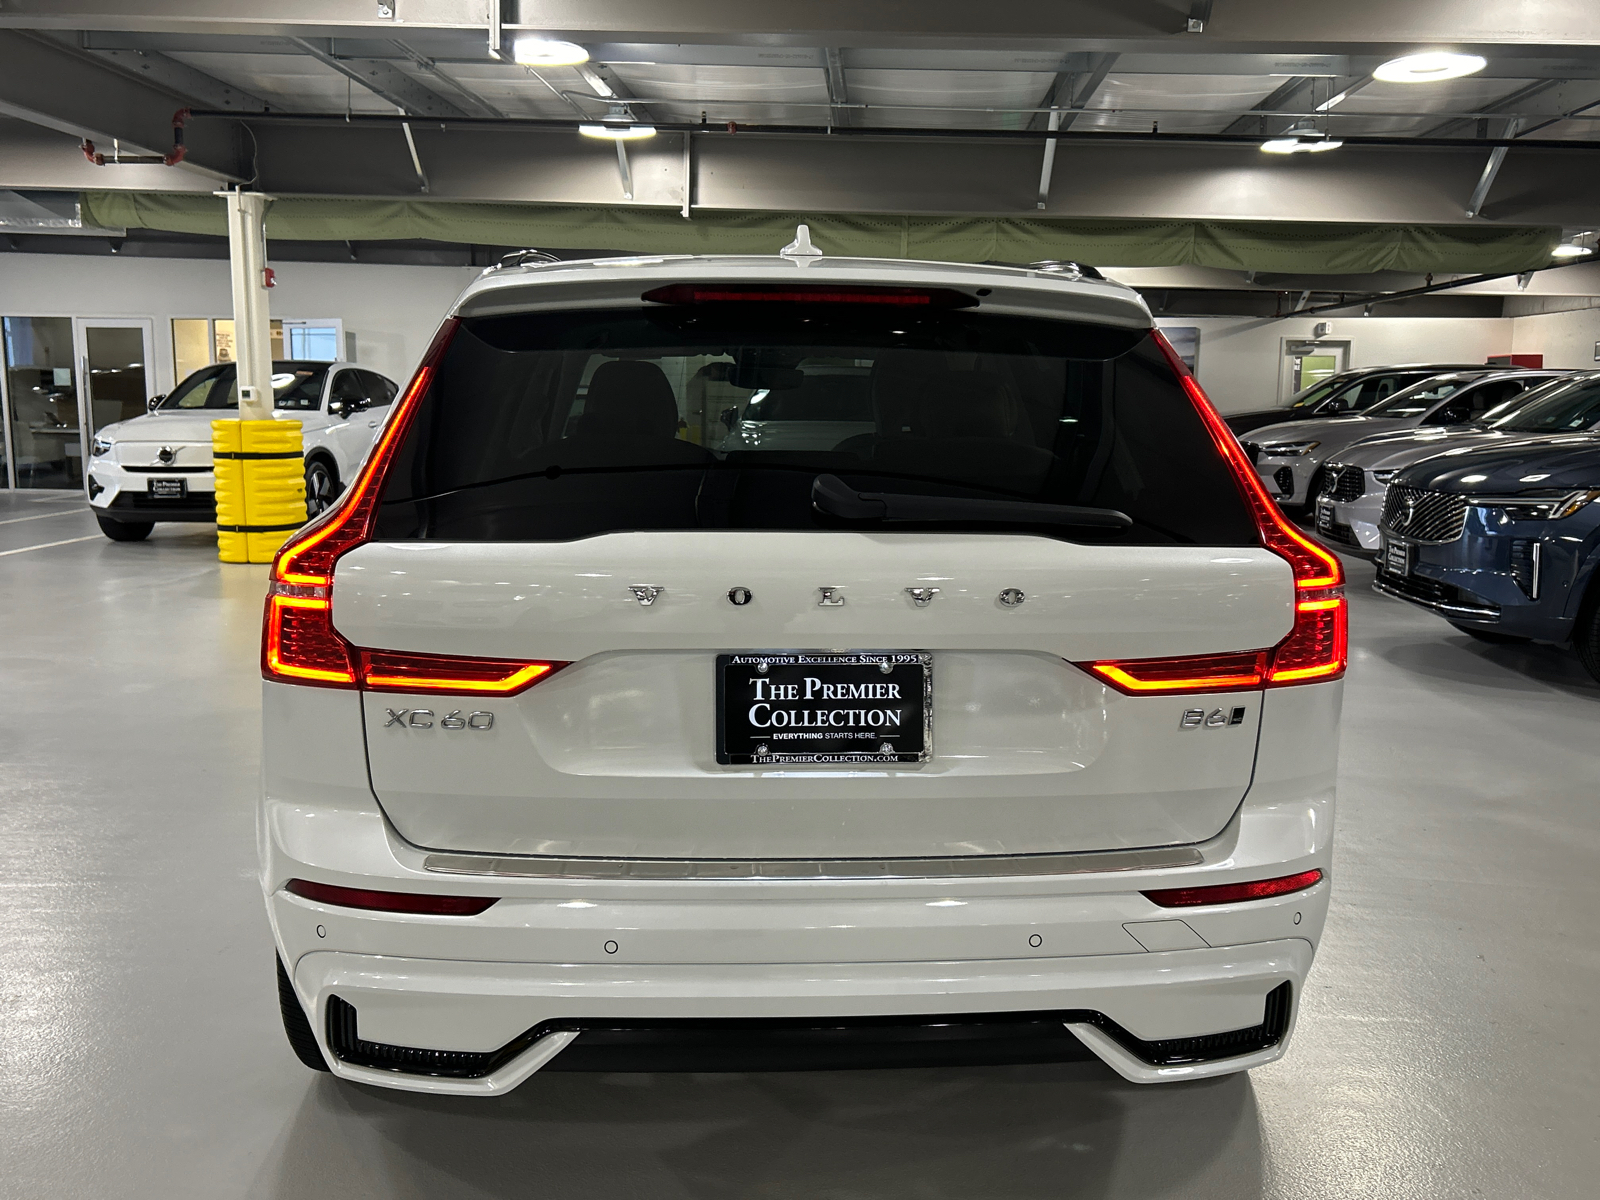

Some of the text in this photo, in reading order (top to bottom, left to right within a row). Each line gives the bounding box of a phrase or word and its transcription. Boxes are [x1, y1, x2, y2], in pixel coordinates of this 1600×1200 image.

[627, 585, 1026, 608] VOLVO
[891, 654, 917, 663] 1995
[748, 677, 902, 701] THE PREMIER
[384, 708, 494, 731] XC60
[748, 703, 902, 728] COLLECTION
[1180, 707, 1228, 728] B6
[772, 732, 824, 740] EVERYTHING
